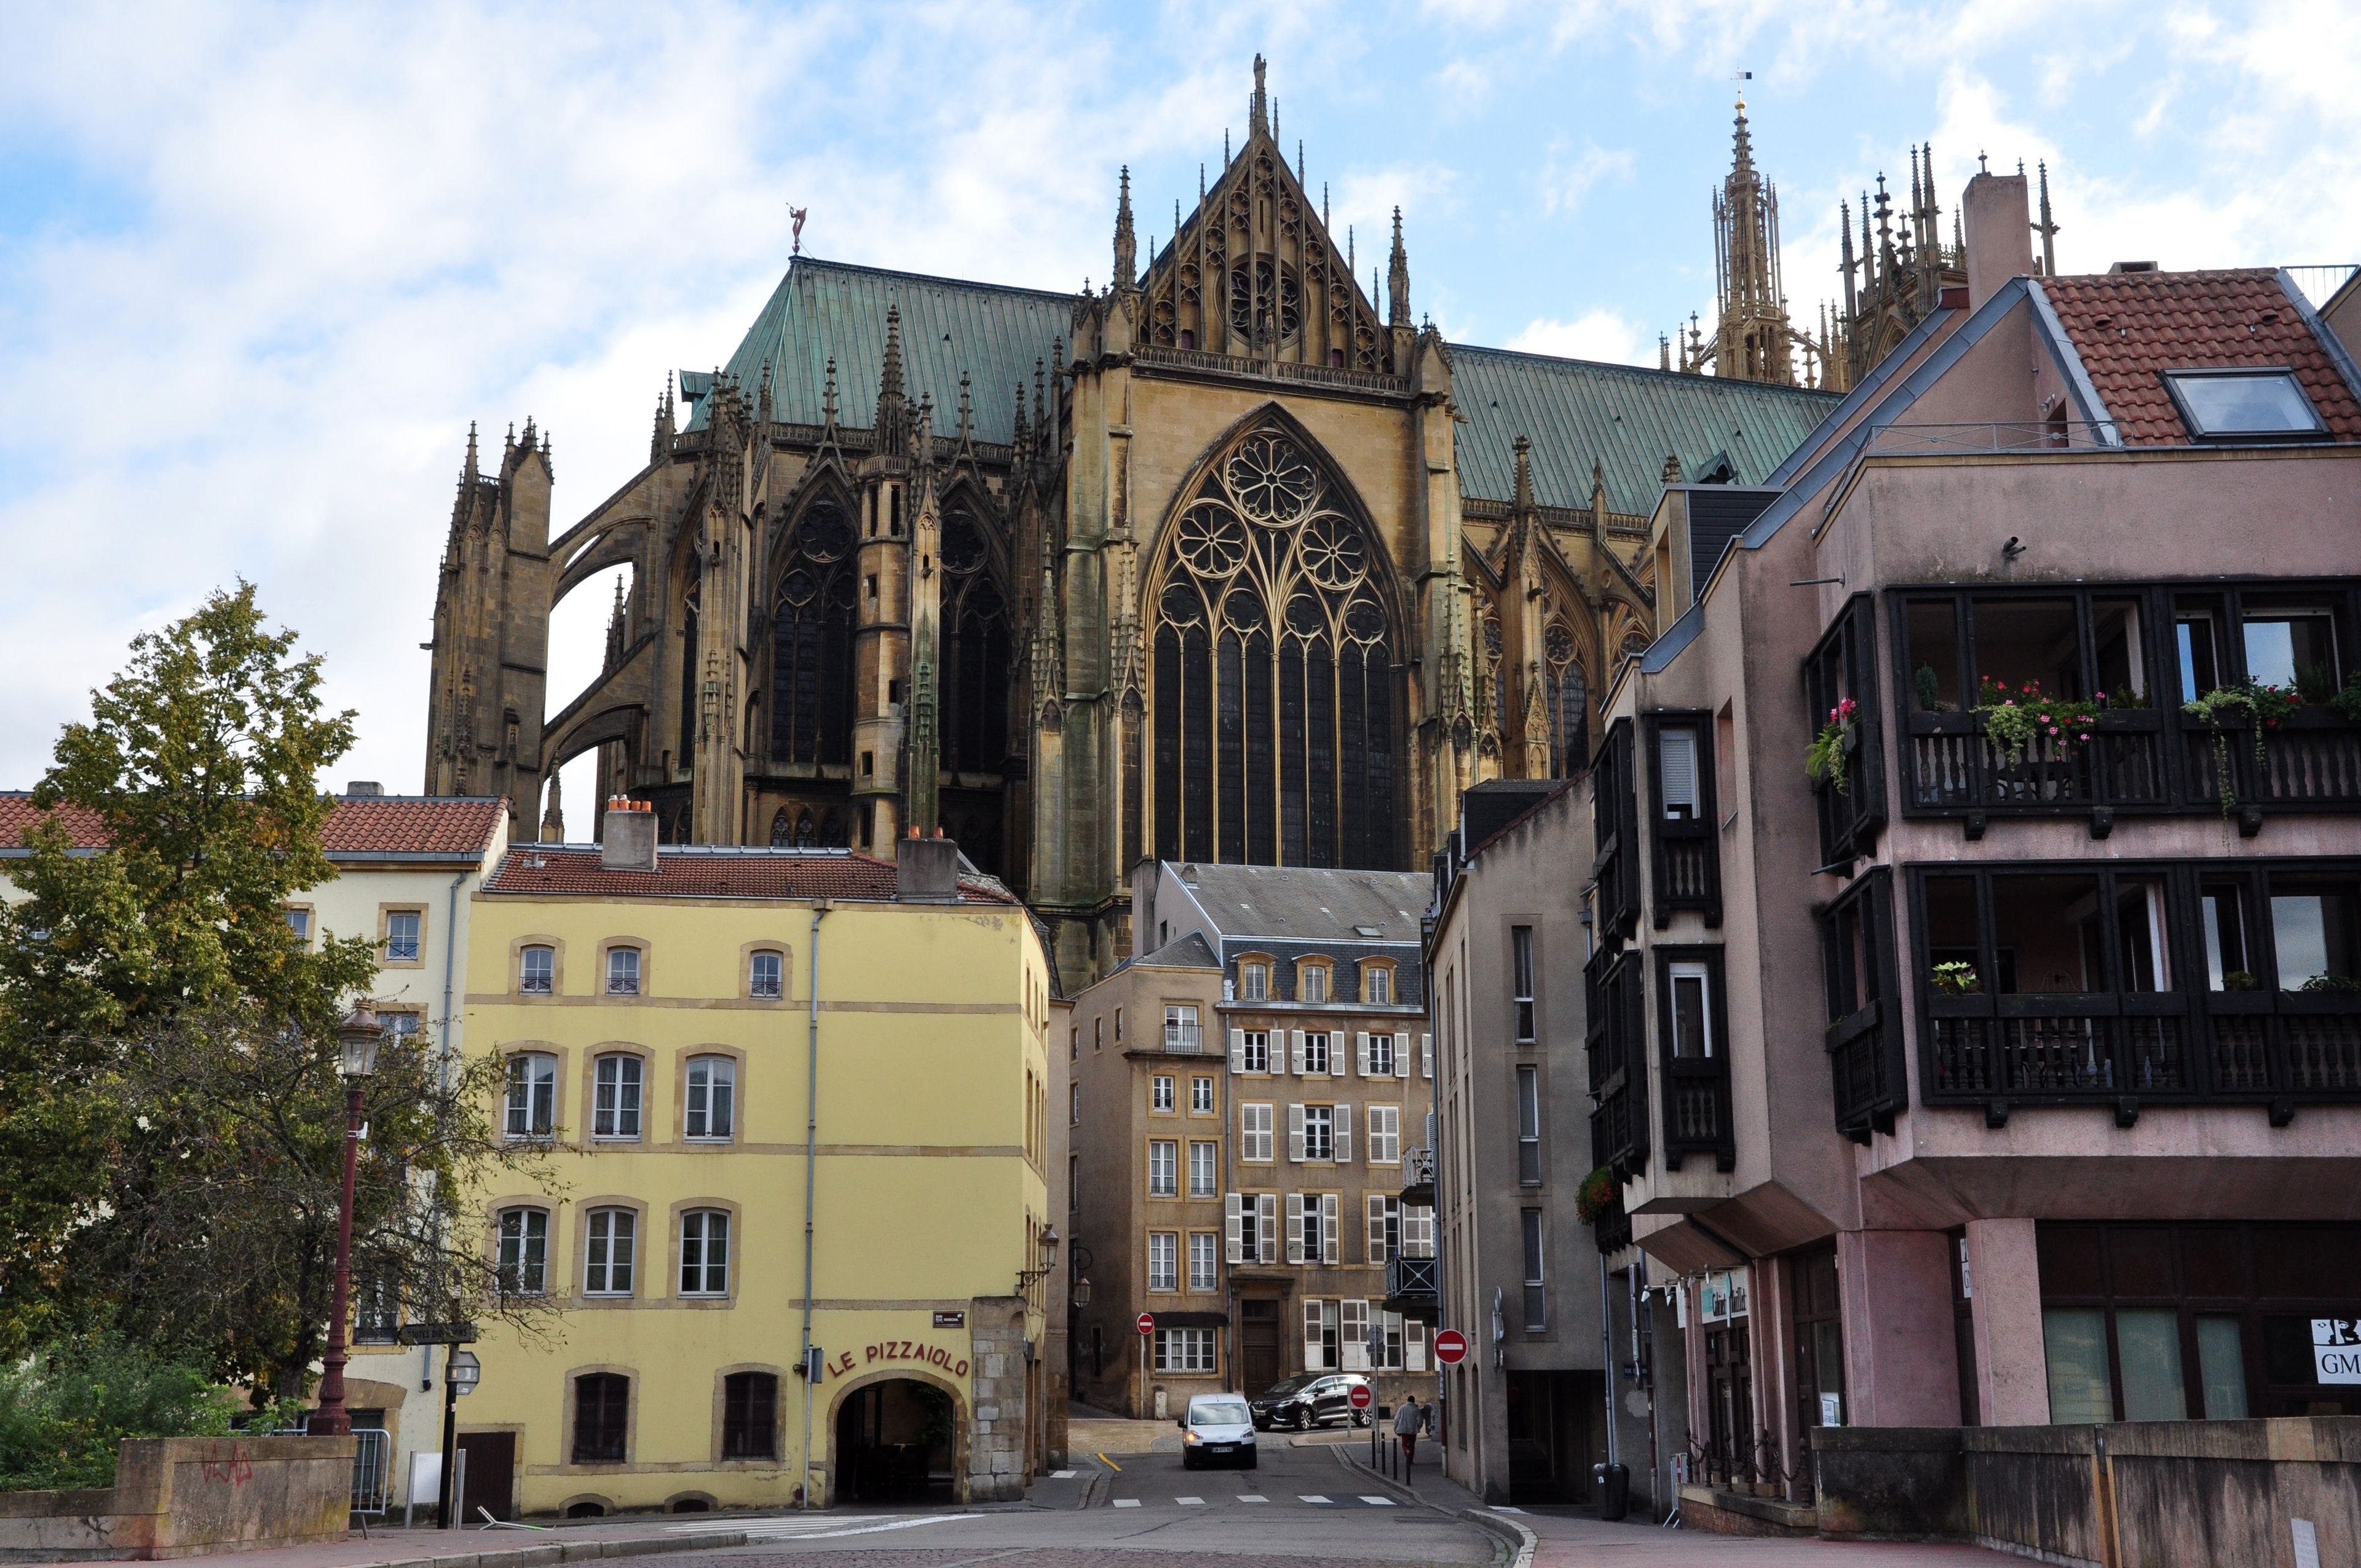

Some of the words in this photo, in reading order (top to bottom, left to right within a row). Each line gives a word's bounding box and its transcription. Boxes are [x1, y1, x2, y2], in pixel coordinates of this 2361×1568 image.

[827, 1350, 856, 1377] LE
[866, 1340, 969, 1377] PIZZAIOLO
[2321, 1353, 2361, 1374] GM
